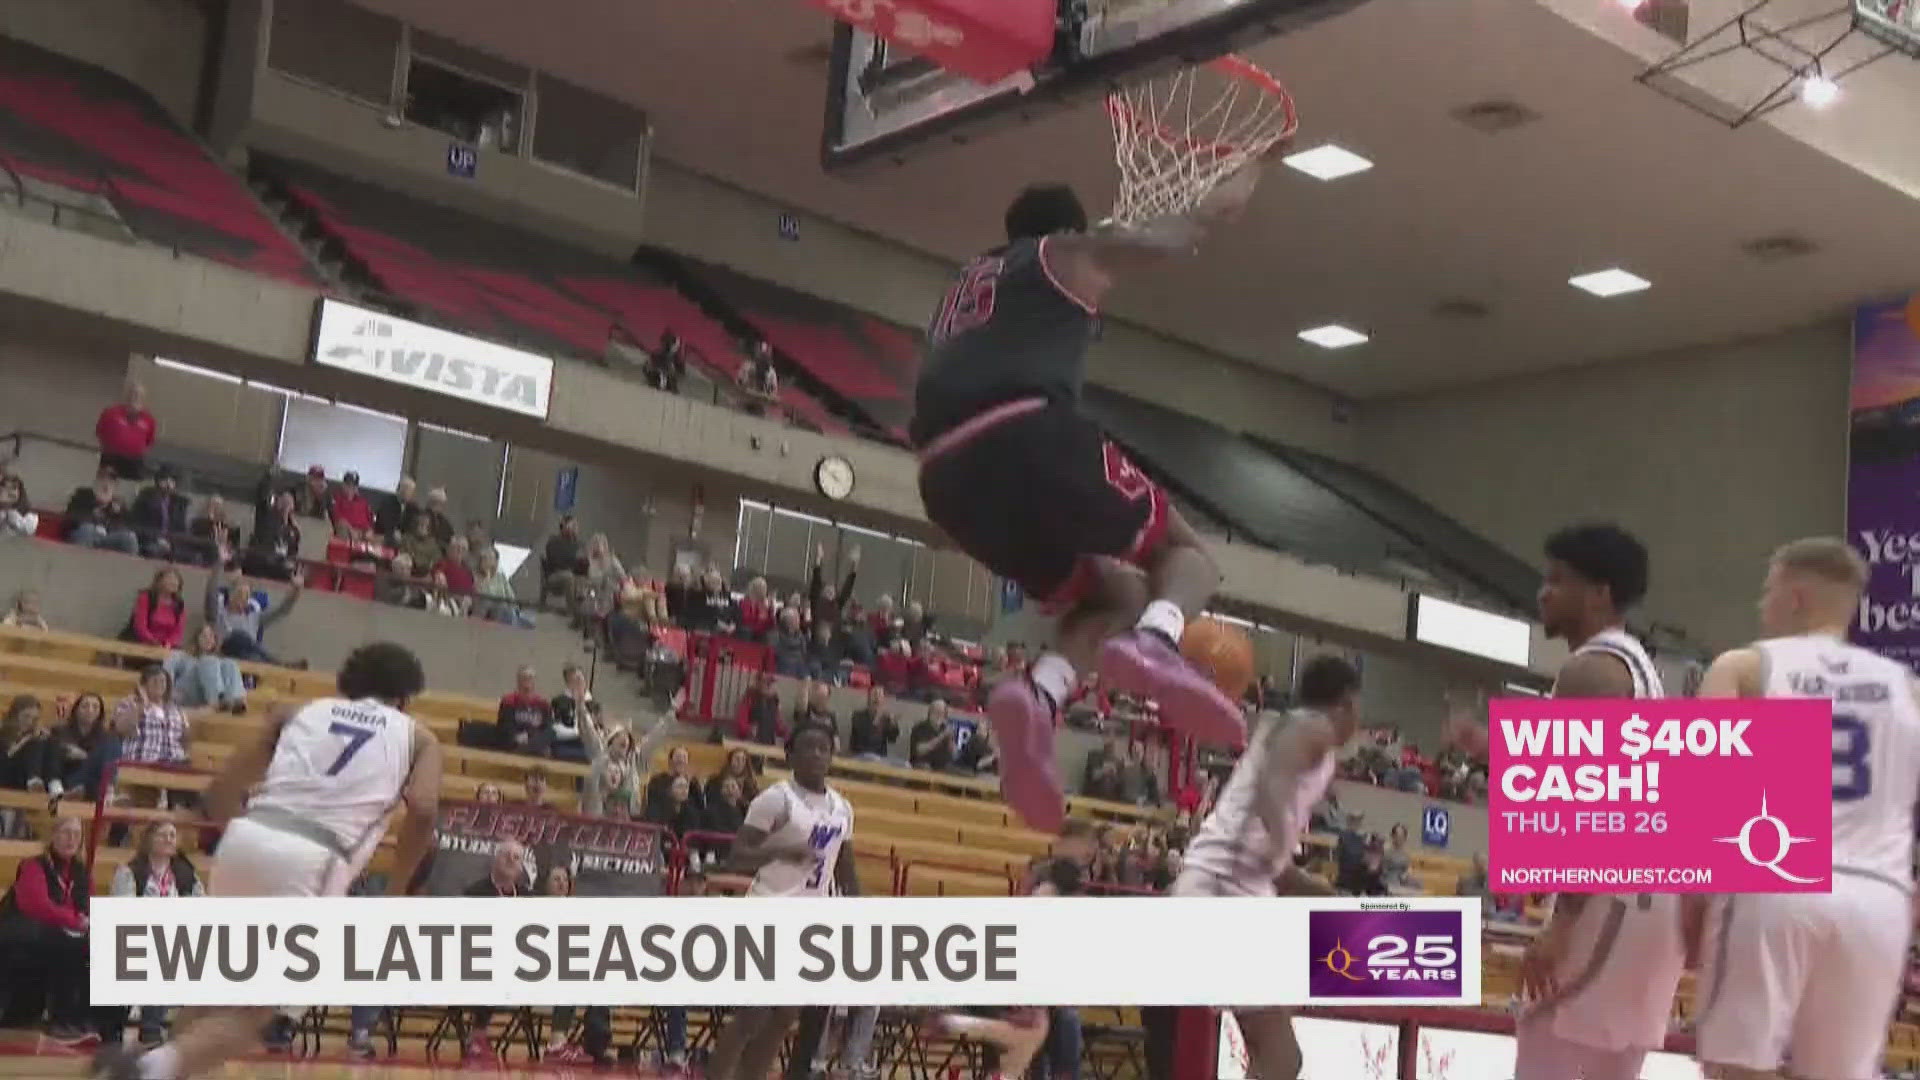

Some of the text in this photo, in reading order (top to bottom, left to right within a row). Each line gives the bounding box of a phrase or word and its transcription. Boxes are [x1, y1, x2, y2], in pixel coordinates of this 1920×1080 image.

[326, 319, 537, 407] AVISTA
[327, 721, 377, 776] 7
[1426, 810, 1448, 836] LQ
[582, 853, 654, 875] SECTION
[806, 857, 825, 889] 3
